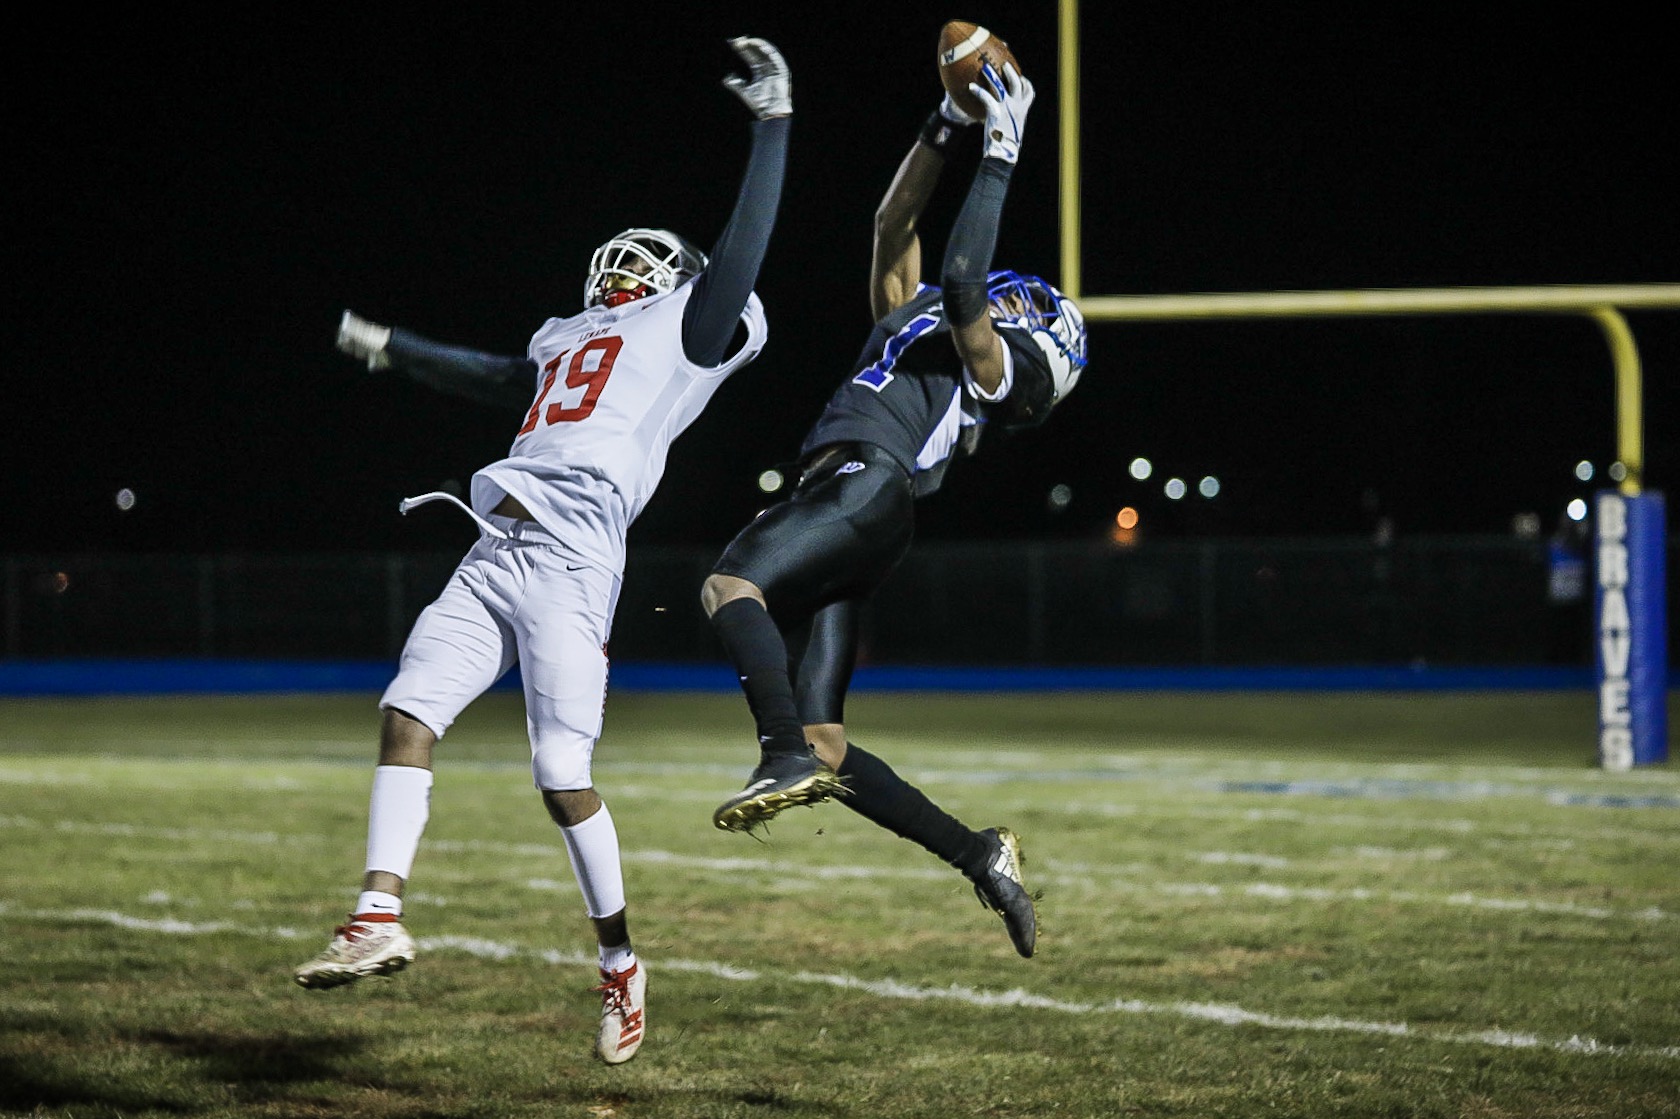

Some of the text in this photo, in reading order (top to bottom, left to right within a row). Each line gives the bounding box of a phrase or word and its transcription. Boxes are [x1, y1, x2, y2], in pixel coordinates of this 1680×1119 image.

[518, 335, 624, 436] 19
[851, 313, 941, 393] 1
[1598, 494, 1634, 771] BRAVES
